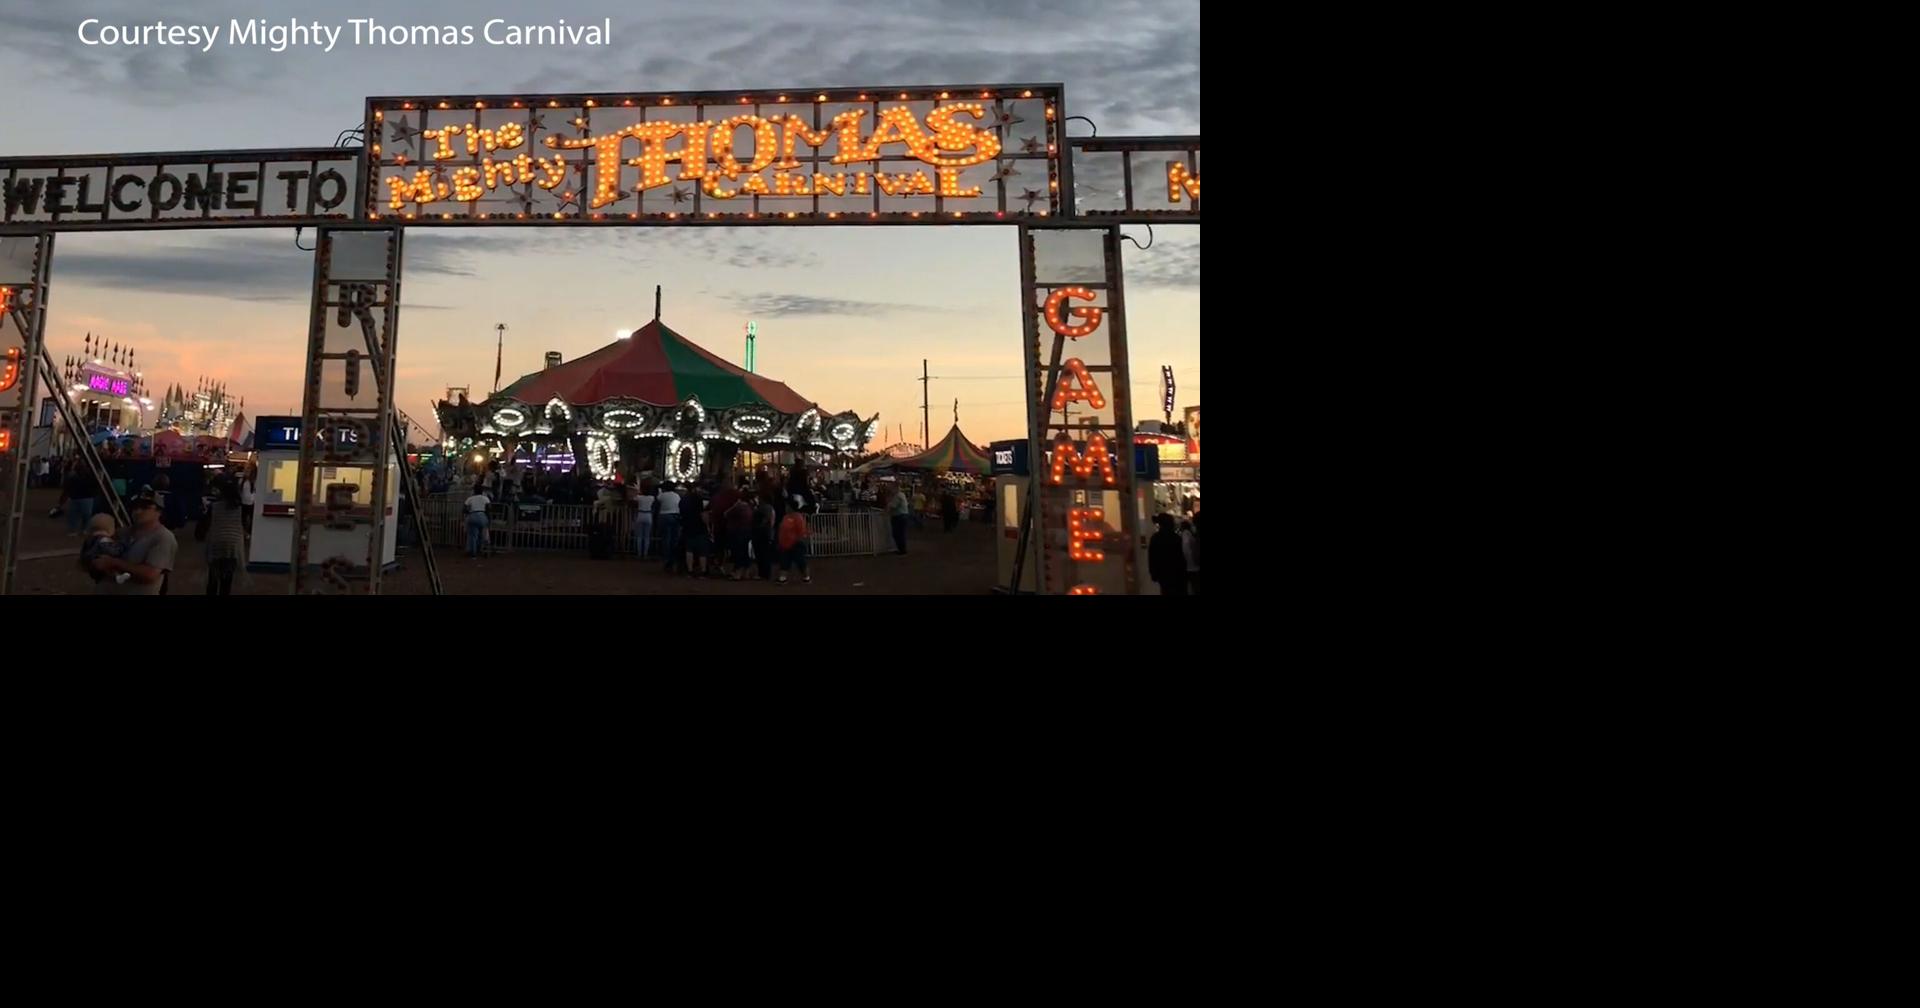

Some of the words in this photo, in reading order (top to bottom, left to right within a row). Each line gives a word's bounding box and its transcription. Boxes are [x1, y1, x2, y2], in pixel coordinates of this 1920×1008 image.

[423, 120, 526, 161] The
[544, 102, 1001, 208] THOMAS
[3, 171, 258, 216] WELCOME
[276, 169, 348, 211] TO
[701, 166, 984, 199] CARNIVAL
[1043, 286, 1116, 594] GAME
